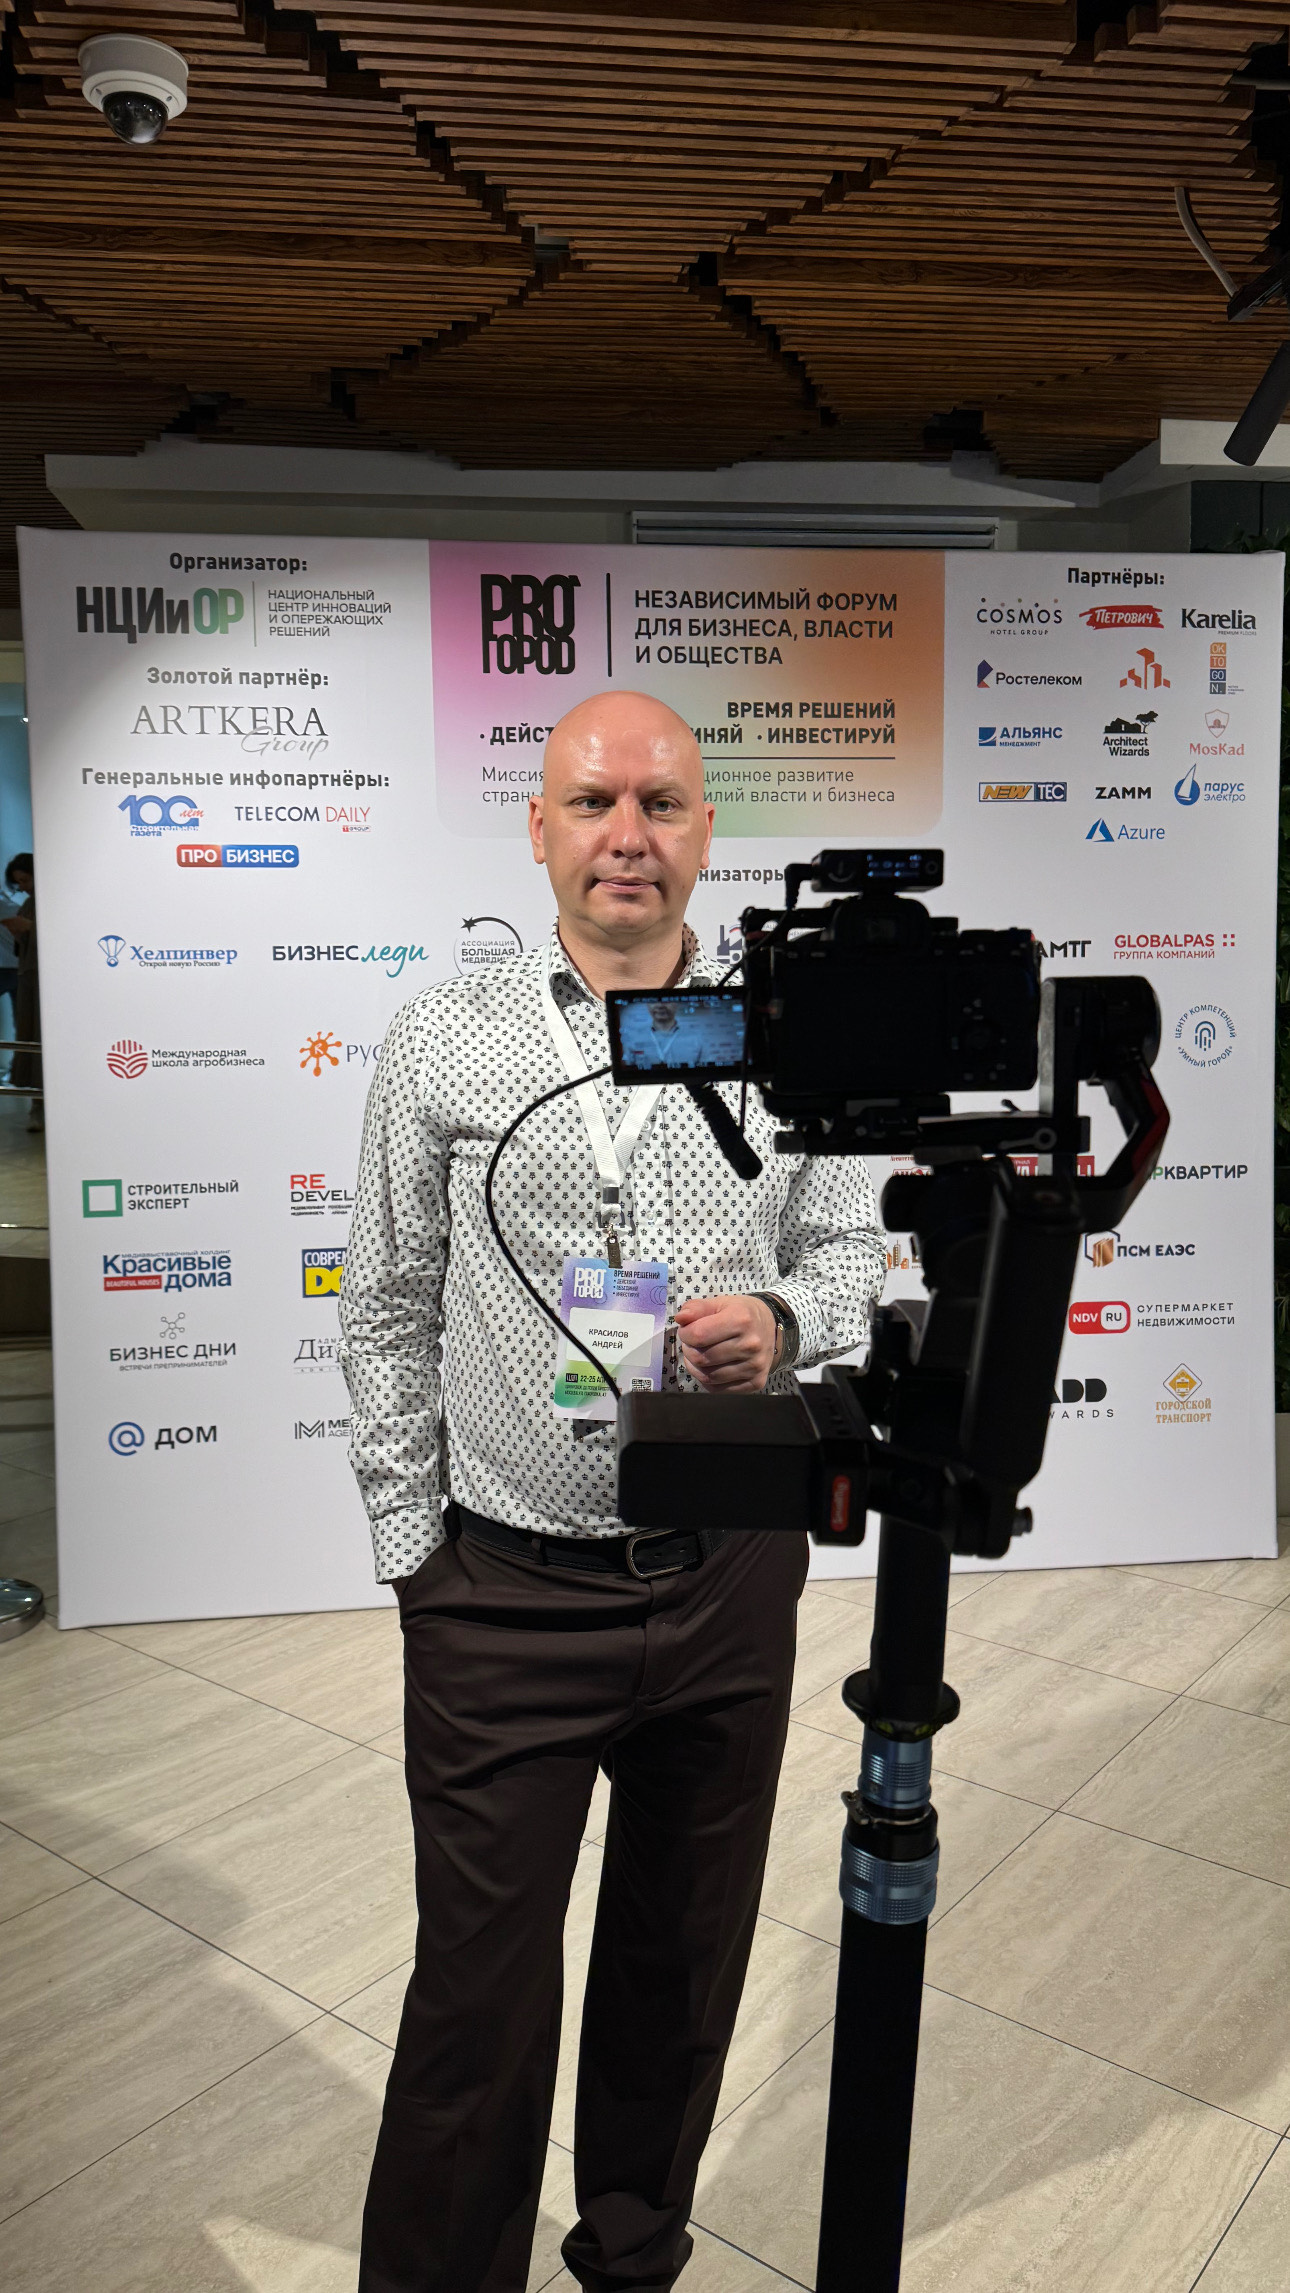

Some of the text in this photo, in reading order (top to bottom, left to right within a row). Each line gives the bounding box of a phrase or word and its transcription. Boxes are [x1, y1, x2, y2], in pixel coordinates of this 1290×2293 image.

[169, 552, 308, 574] Организатор:
[1067, 567, 1165, 588] Партнёры:
[268, 589, 375, 601] НАЦИОНАЛЬНЫЙ
[634, 588, 898, 612] НЕЗАВИСИМЫЙ ФОРУМ
[268, 602, 392, 614] ЦЕНТР ИННОВАЦИЙ
[481, 574, 581, 638] PRO
[269, 614, 384, 626] И ОПЕРЕЖАЮЩИХ
[976, 608, 1063, 624] COSMOS
[1181, 608, 1256, 630] Karelia
[269, 625, 331, 637] РЕШЕНИЙ
[634, 618, 894, 642] ДЛЯ БИЗНЕСА, ВЛАСТИ
[635, 645, 783, 667] И ОБЩЕСТВА
[147, 667, 329, 689] Золотой партнёр:
[996, 672, 1082, 686] Ростелеком
[727, 699, 896, 718] ВРЕМЯ РЕШЕНИЙ
[131, 705, 328, 736] ARTKERA
[767, 724, 896, 744] ИНВЕСТИРУЙ
[1000, 727, 1063, 739] АЛЬЯНС
[241, 726, 329, 760] Group
[1103, 736, 1148, 747] Architect
[1109, 747, 1150, 757] Wizards
[1189, 743, 1245, 756] MosKad
[82, 768, 390, 789] Генеральные инфопартнёры:
[777, 770, 854, 786] развитие
[704, 787, 895, 802] илий власти и бизнеса
[982, 784, 1065, 800] NEW TEC
[1095, 787, 1152, 799] ZAMM
[1203, 781, 1245, 794] парус
[482, 791, 543, 806] стран
[1203, 792, 1246, 803] электро
[235, 806, 371, 822] TELECOM DAILY
[1118, 825, 1166, 840] Azure
[181, 849, 294, 863] ПРО БИЗНЕС
[699, 869, 784, 884] низатор
[1114, 934, 1215, 948] GLOBALPAS
[130, 945, 238, 964] Хелпинвер
[272, 945, 359, 961] БИЗНЕС
[461, 948, 515, 956] БОЛЬШАЯ
[1114, 948, 1215, 959] ГРУППА КОМПАНИЙ
[139, 961, 167, 969] Открой
[1174, 1004, 1237, 1039] ЦЕНТР КОМПЕТЕНЦИЙ
[151, 1049, 247, 1061] Международная
[152, 1057, 265, 1068] школа агробизнеса
[1150, 1165, 1248, 1180] РКВАРТИР
[128, 1180, 239, 1196] СТРОИТЕЛЬНЫЙ
[290, 1174, 326, 1190] RE
[290, 1190, 355, 1203] DEVEL
[128, 1198, 189, 1210] ЭКСПЕРТ
[1117, 1244, 1196, 1257] ПСМ ЕАЭС
[103, 1254, 232, 1277] Красивые
[613, 1269, 660, 1280] ВРЕМЯ РЕШЕНИЙ
[1137, 1303, 1234, 1313] СУПЕРМАРКЕТ
[1073, 1312, 1122, 1323] NDV RU
[1137, 1316, 1235, 1328] НЕДВИЖИМОСТИ
[588, 1328, 629, 1339] КРАСИЛОВ
[109, 1342, 236, 1361] БИЗНЕС ДНИ
[592, 1339, 623, 1350] АНДРЕЙ
[1053, 1378, 1107, 1403] DD
[1155, 1398, 1212, 1411] ГОРОДСКОЙ
[327, 1419, 350, 1428] ME
[1155, 1413, 1212, 1424] ТРАНСПОРТ
[155, 1425, 217, 1450] ДОМ
